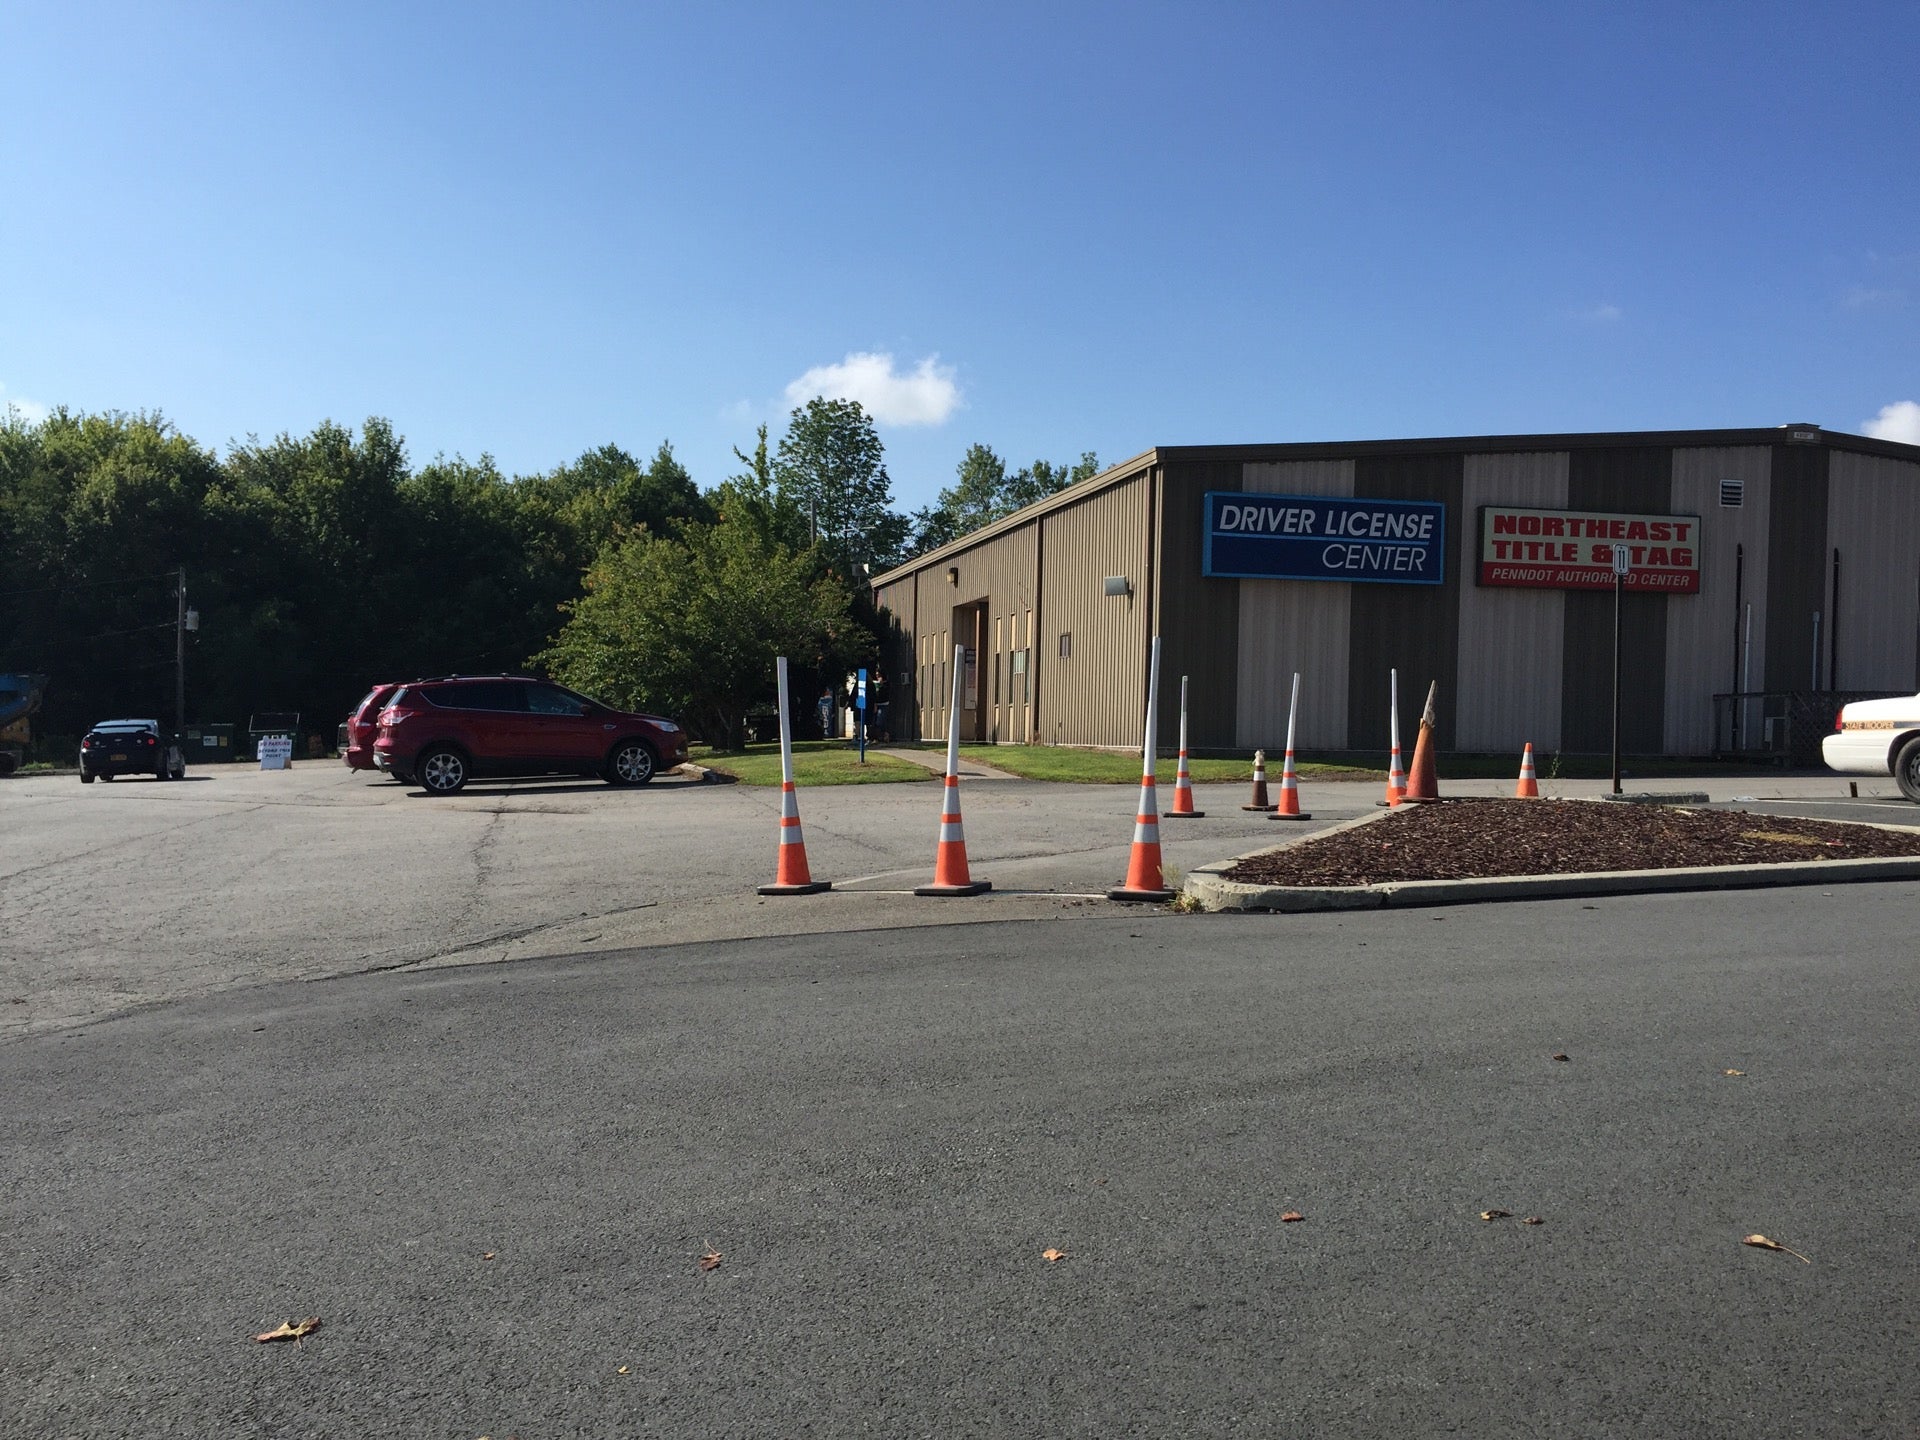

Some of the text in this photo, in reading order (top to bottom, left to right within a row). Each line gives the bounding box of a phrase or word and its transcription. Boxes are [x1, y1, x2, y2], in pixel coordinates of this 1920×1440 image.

[1219, 505, 1435, 539] DRIVER LICENSE
[1494, 515, 1692, 541] NORTHEAST
[1322, 544, 1427, 572] CENTER
[1492, 540, 1693, 567] TITLE & TAG
[1492, 568, 1554, 581] PENNDOT
[1641, 573, 1690, 587] CENTER
[1845, 721, 1894, 730] STATE TROOPER
